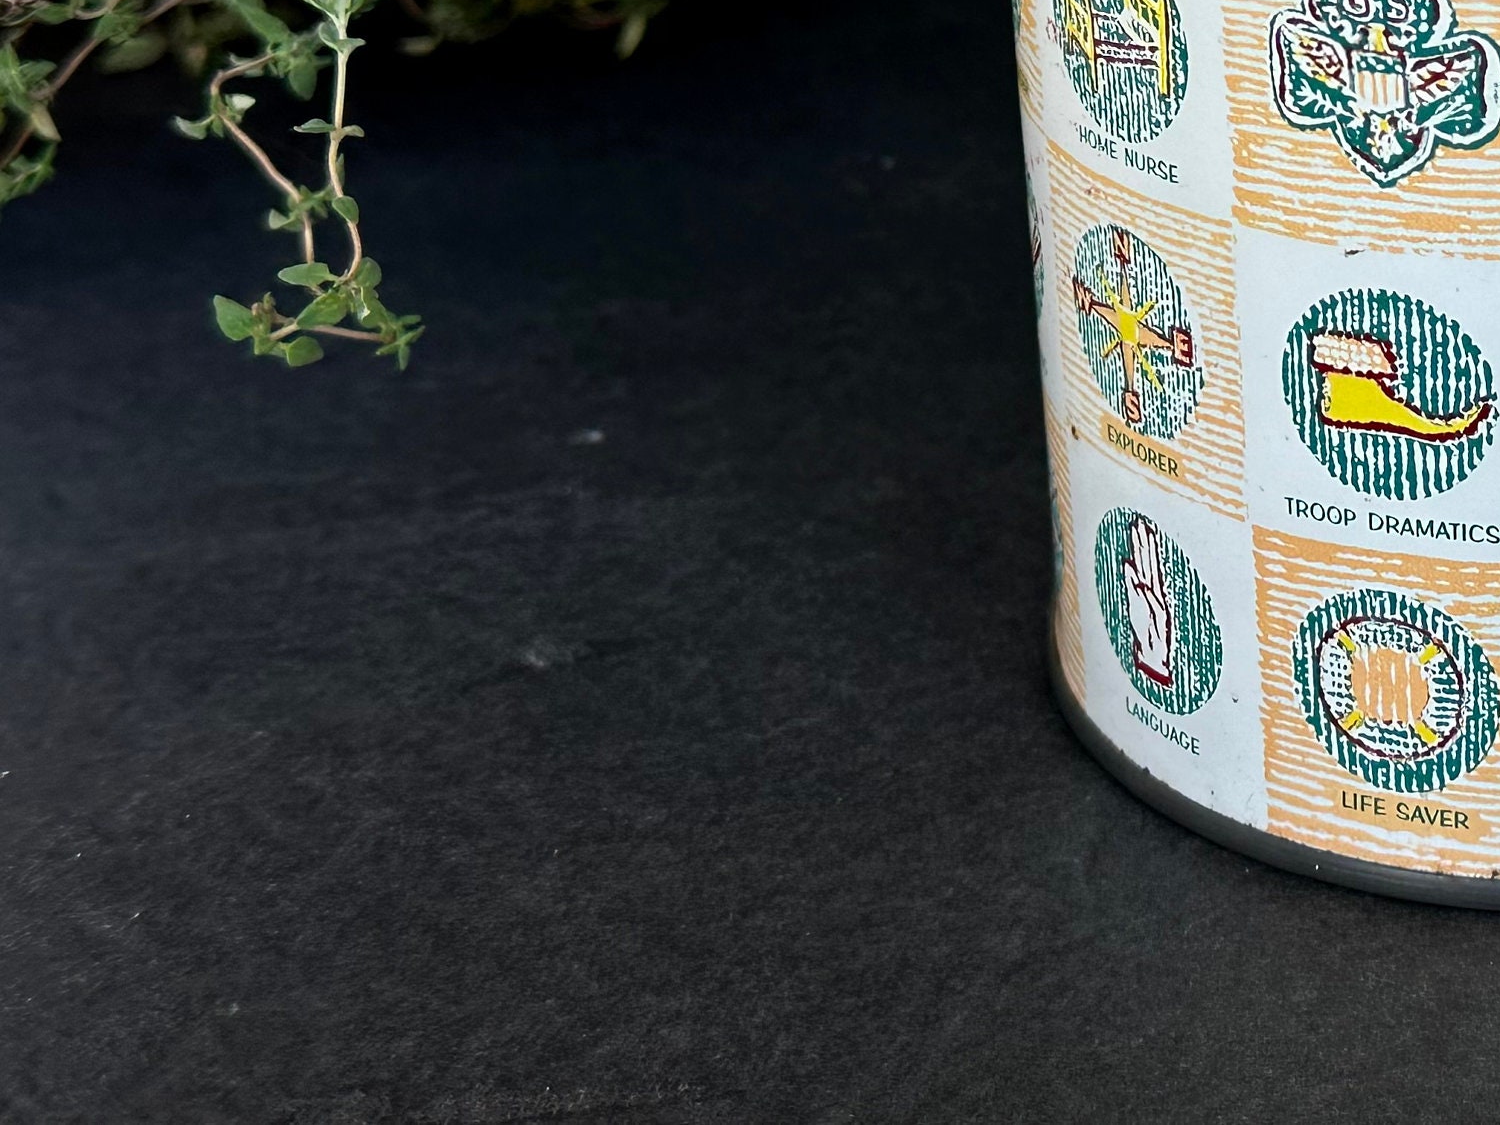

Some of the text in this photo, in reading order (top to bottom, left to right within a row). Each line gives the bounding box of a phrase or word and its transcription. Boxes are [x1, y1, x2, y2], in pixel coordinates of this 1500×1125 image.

[1079, 124, 1180, 184] HOME NURSE
[1107, 423, 1180, 477] EXPLORER
[1284, 496, 1500, 545] TROOP DRAMATICS
[1125, 696, 1201, 756] LANGUAGE
[1341, 790, 1470, 830] LIFE SAVER
